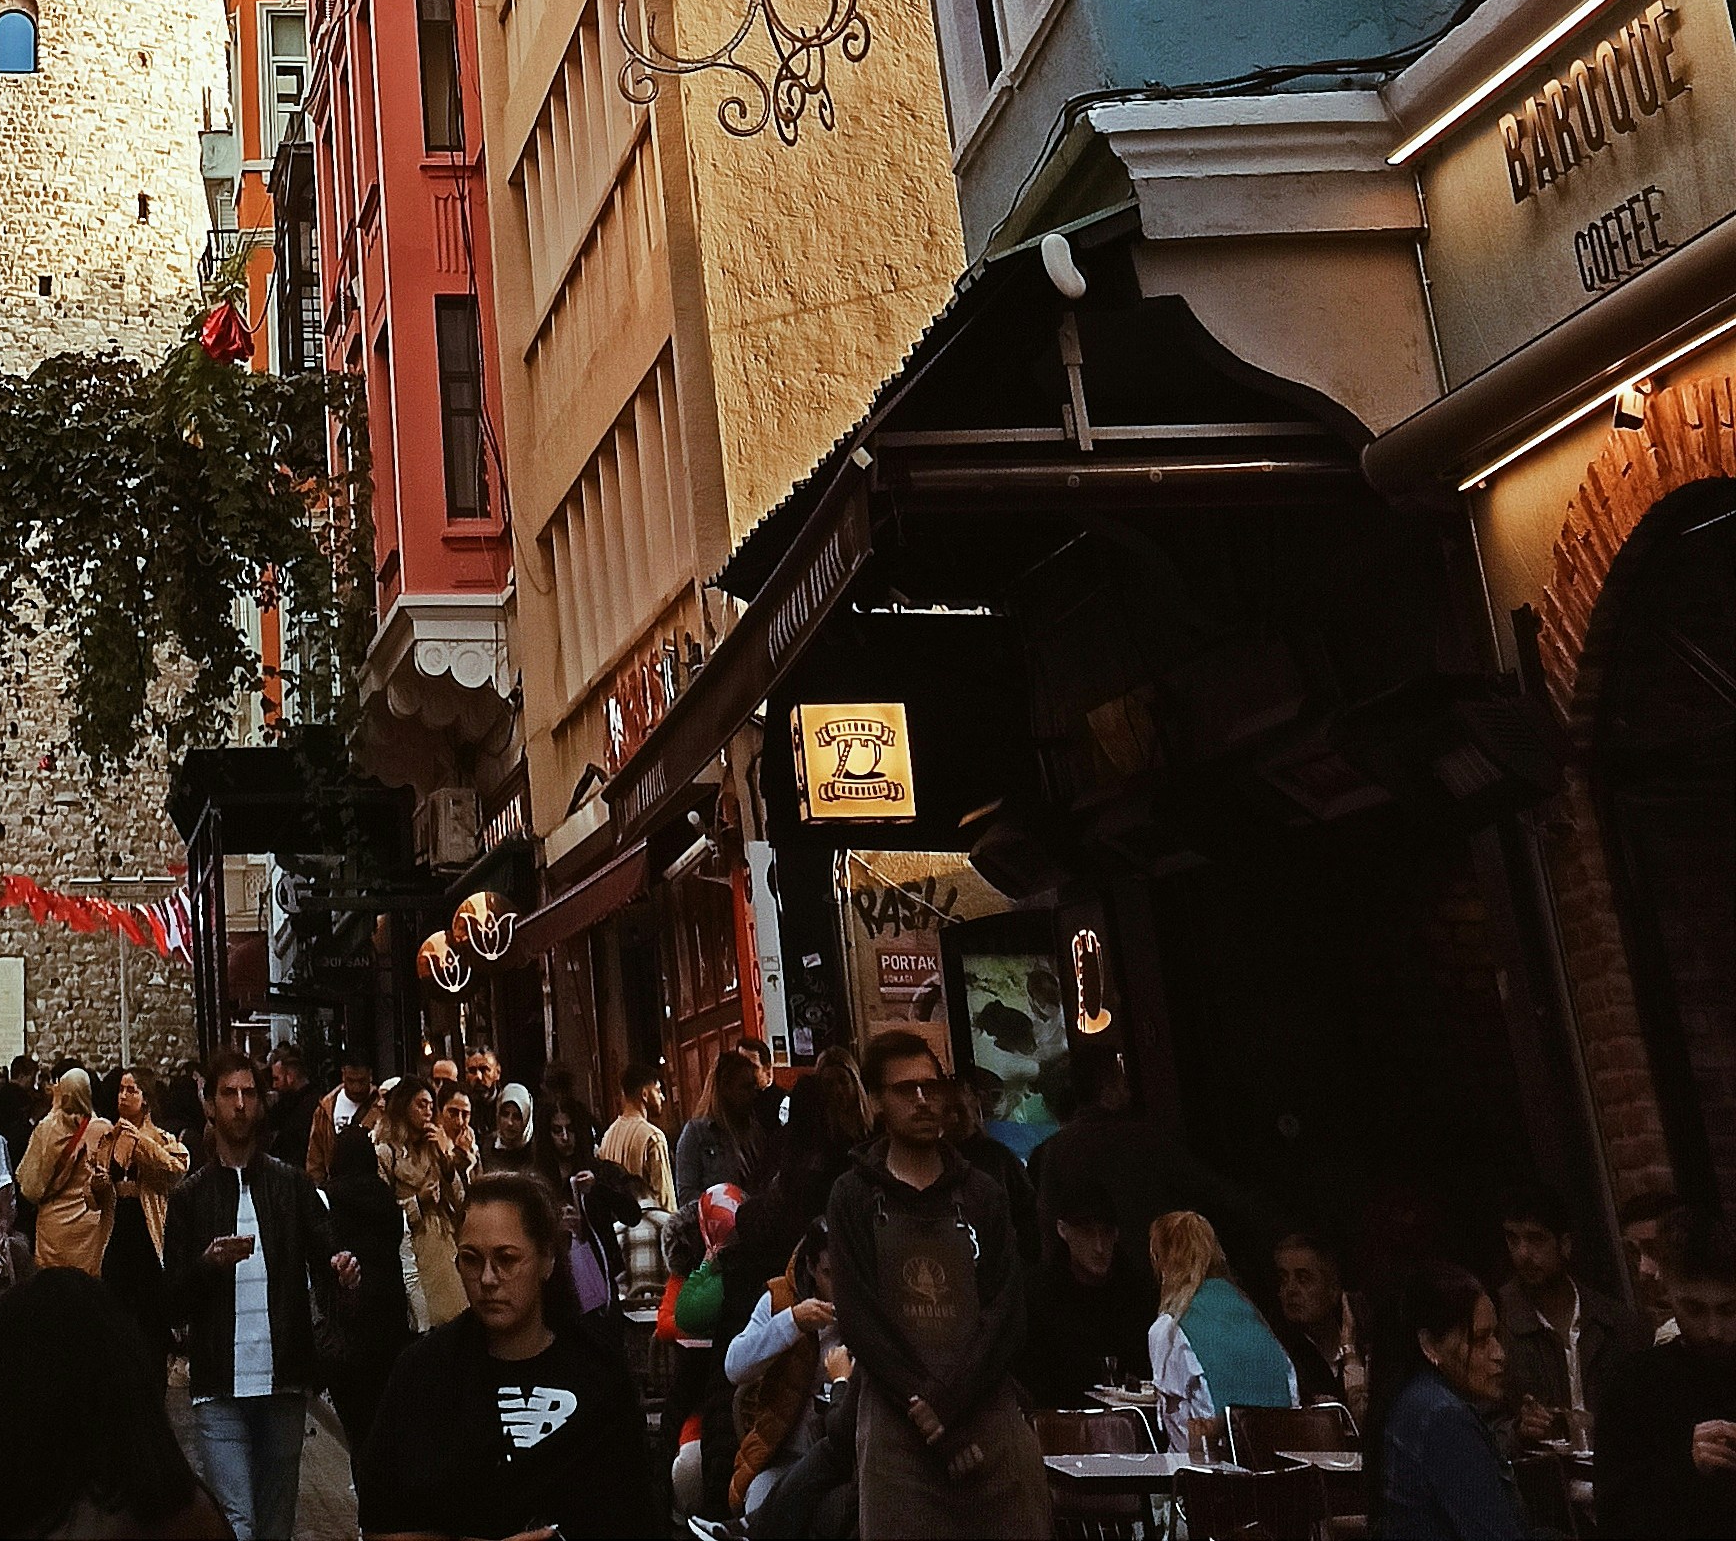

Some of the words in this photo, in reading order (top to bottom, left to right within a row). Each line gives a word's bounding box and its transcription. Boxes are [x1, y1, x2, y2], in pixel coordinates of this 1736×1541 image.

[1498, 0, 1686, 205] BAROQUE
[1573, 184, 1670, 293] COFFEE
[880, 954, 938, 971] PORTAK
